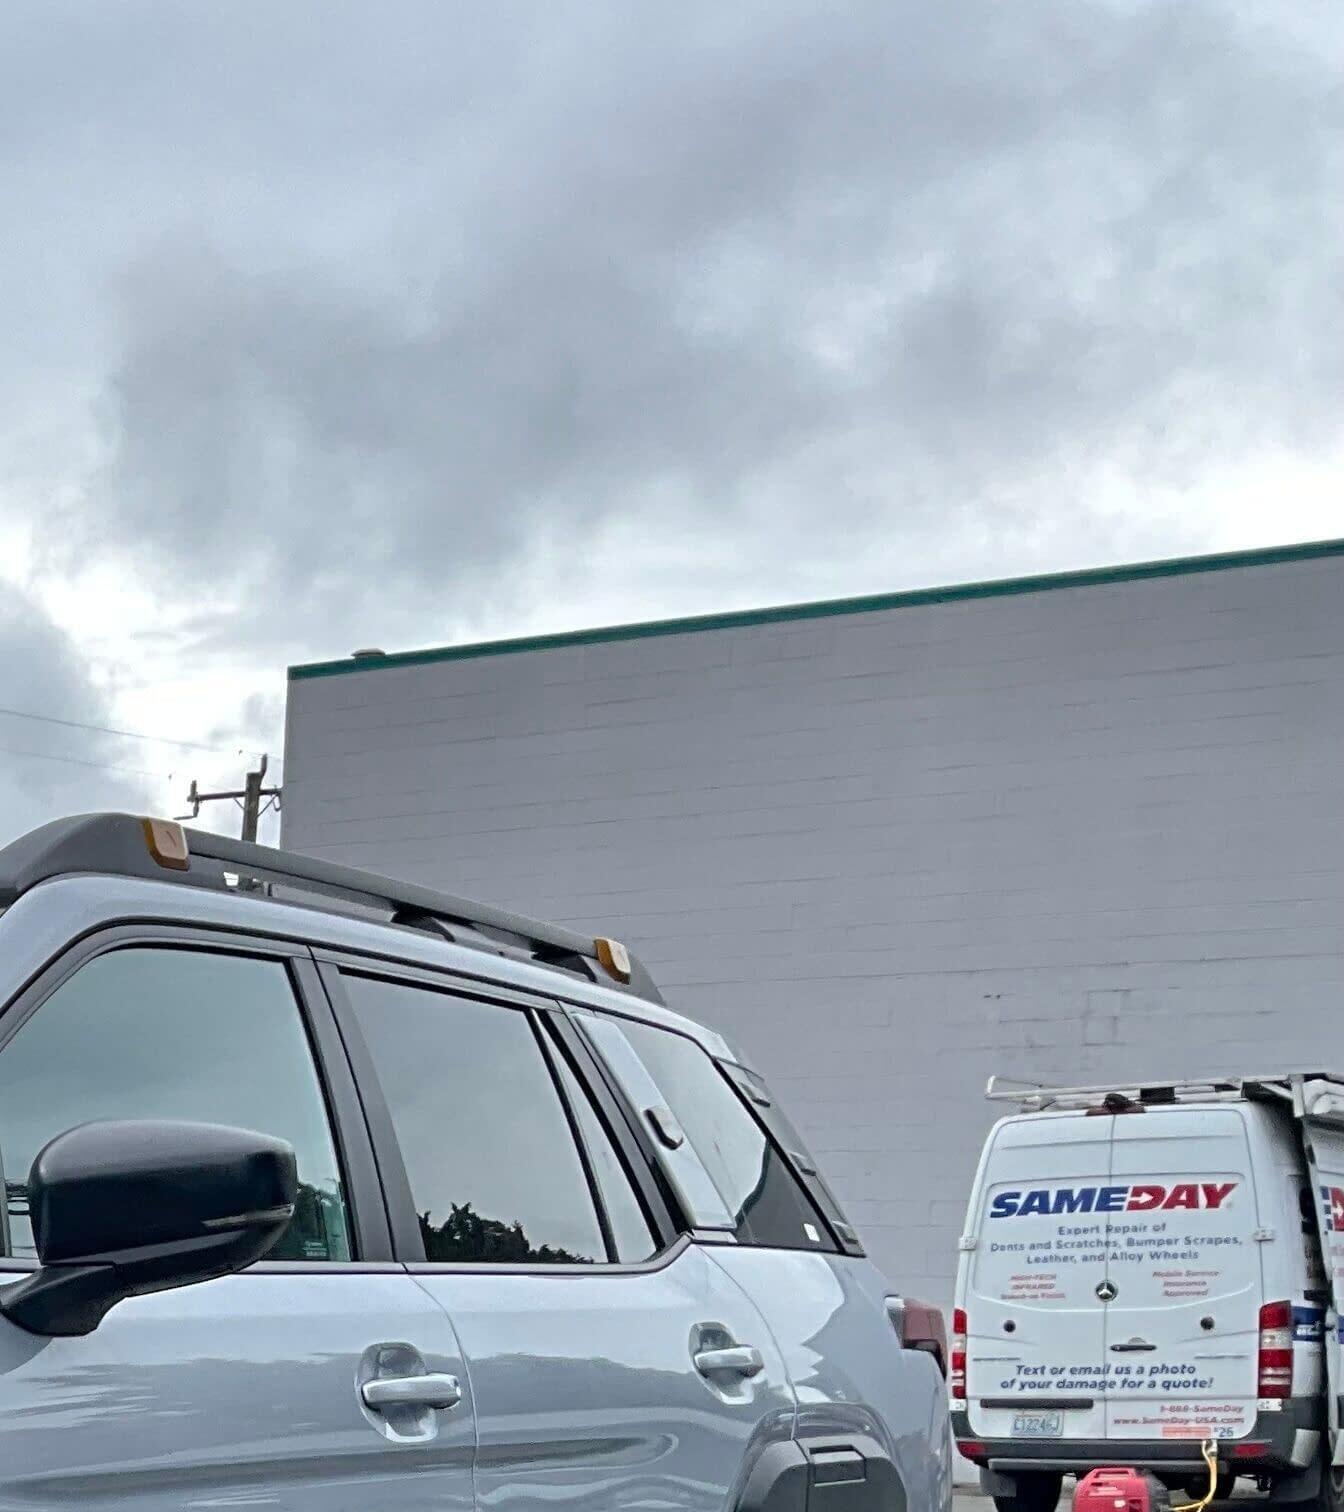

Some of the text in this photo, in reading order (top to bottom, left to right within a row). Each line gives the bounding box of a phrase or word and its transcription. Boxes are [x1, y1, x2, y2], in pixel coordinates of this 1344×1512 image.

[990, 1183, 1238, 1218] SAMEDAY
[1058, 1222, 1167, 1236] Expert Repair of
[990, 1234, 1243, 1252] Dents and Scratches, Bumper Scrapes,
[1026, 1250, 1199, 1264] Leather, and Alloy Wheels
[1016, 1363, 1196, 1377] Text or email us a photo
[1000, 1377, 1214, 1391] of your damage for a quote!
